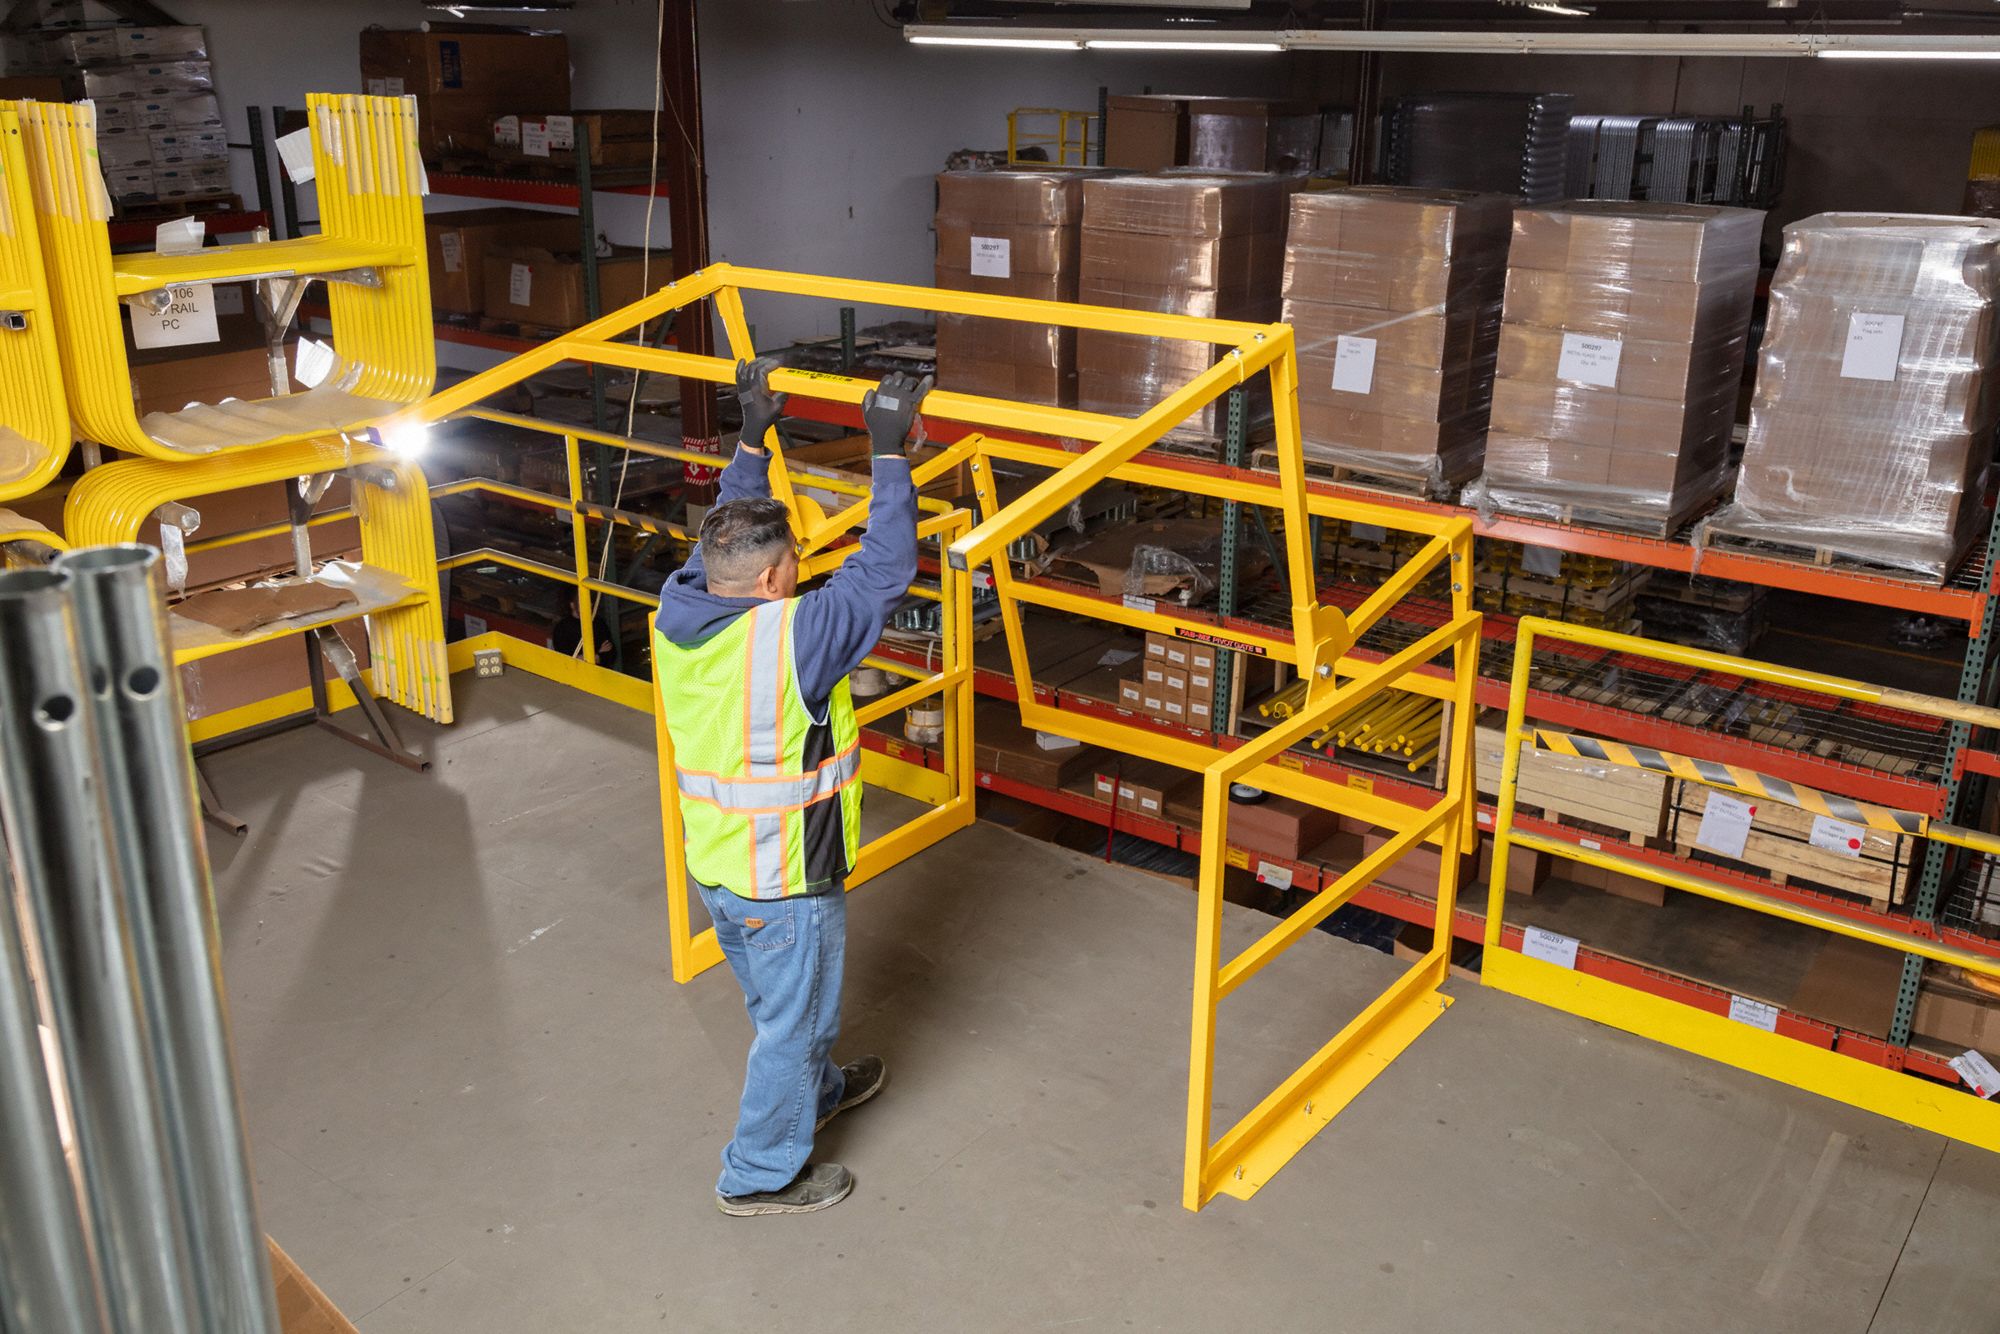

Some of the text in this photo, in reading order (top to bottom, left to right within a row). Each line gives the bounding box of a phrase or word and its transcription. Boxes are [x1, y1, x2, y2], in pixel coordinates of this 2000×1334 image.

[171, 302, 199, 314] RAIL
[162, 318, 181, 331] PC
[1212, 636, 1233, 647] PIVOT
[1234, 642, 1254, 652] GATE
